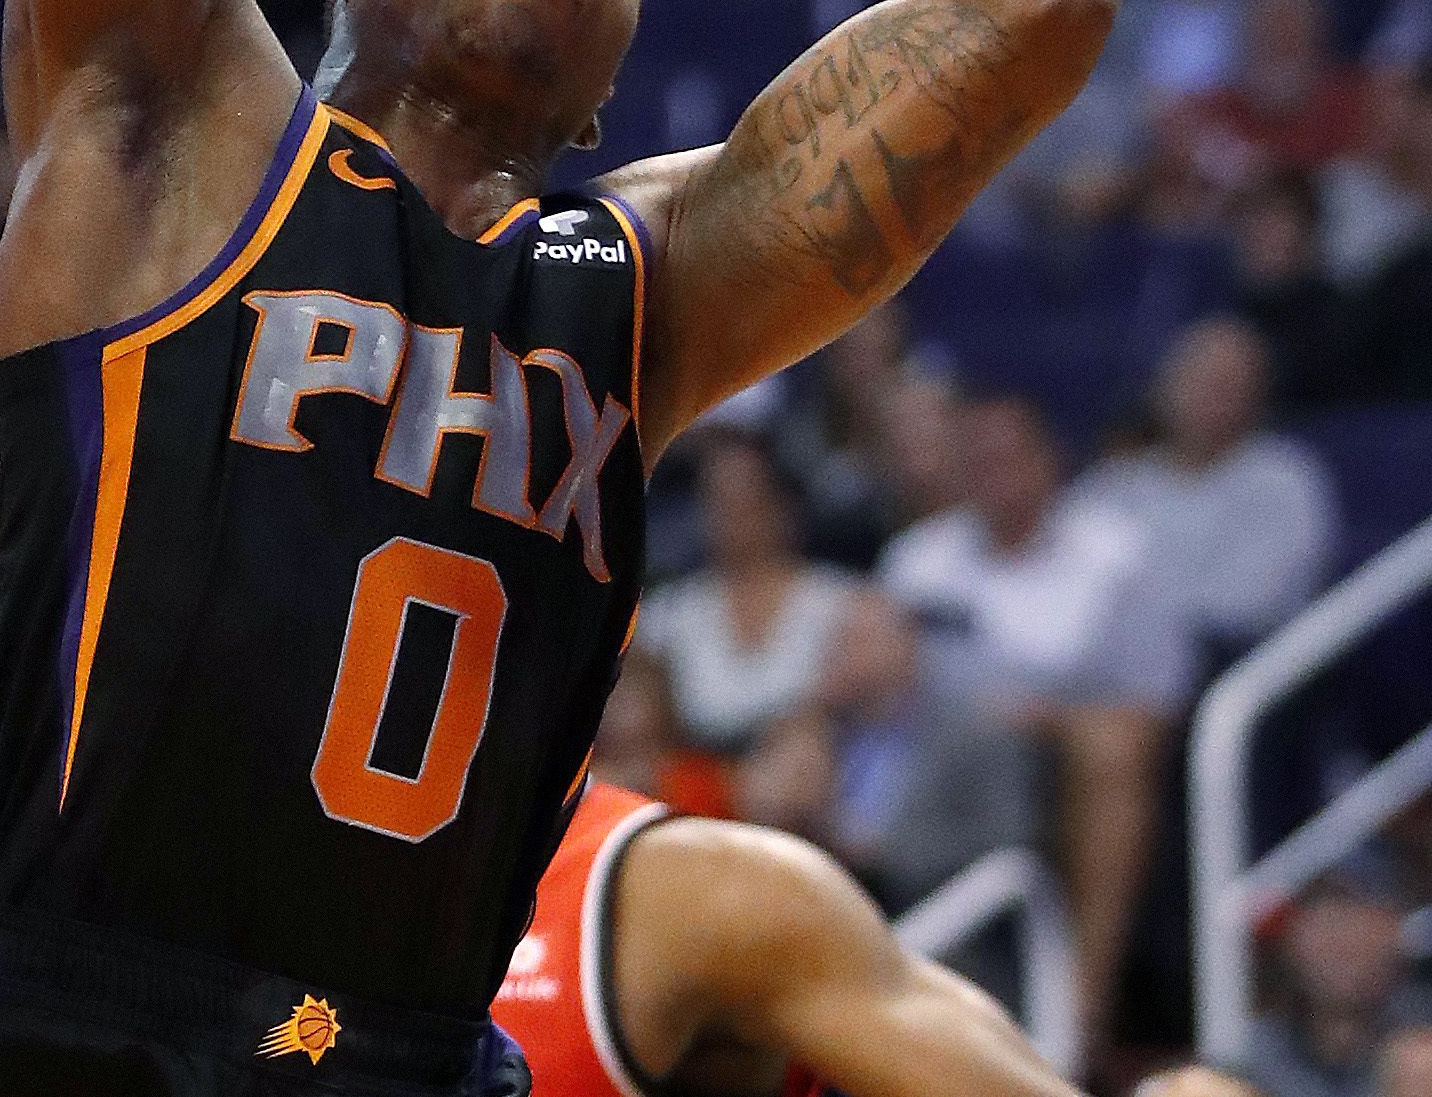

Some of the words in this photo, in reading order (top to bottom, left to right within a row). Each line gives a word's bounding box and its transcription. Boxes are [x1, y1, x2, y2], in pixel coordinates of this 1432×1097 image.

[532, 238, 627, 264] PayPal
[230, 290, 632, 583] PHX
[310, 535, 509, 844] 0
